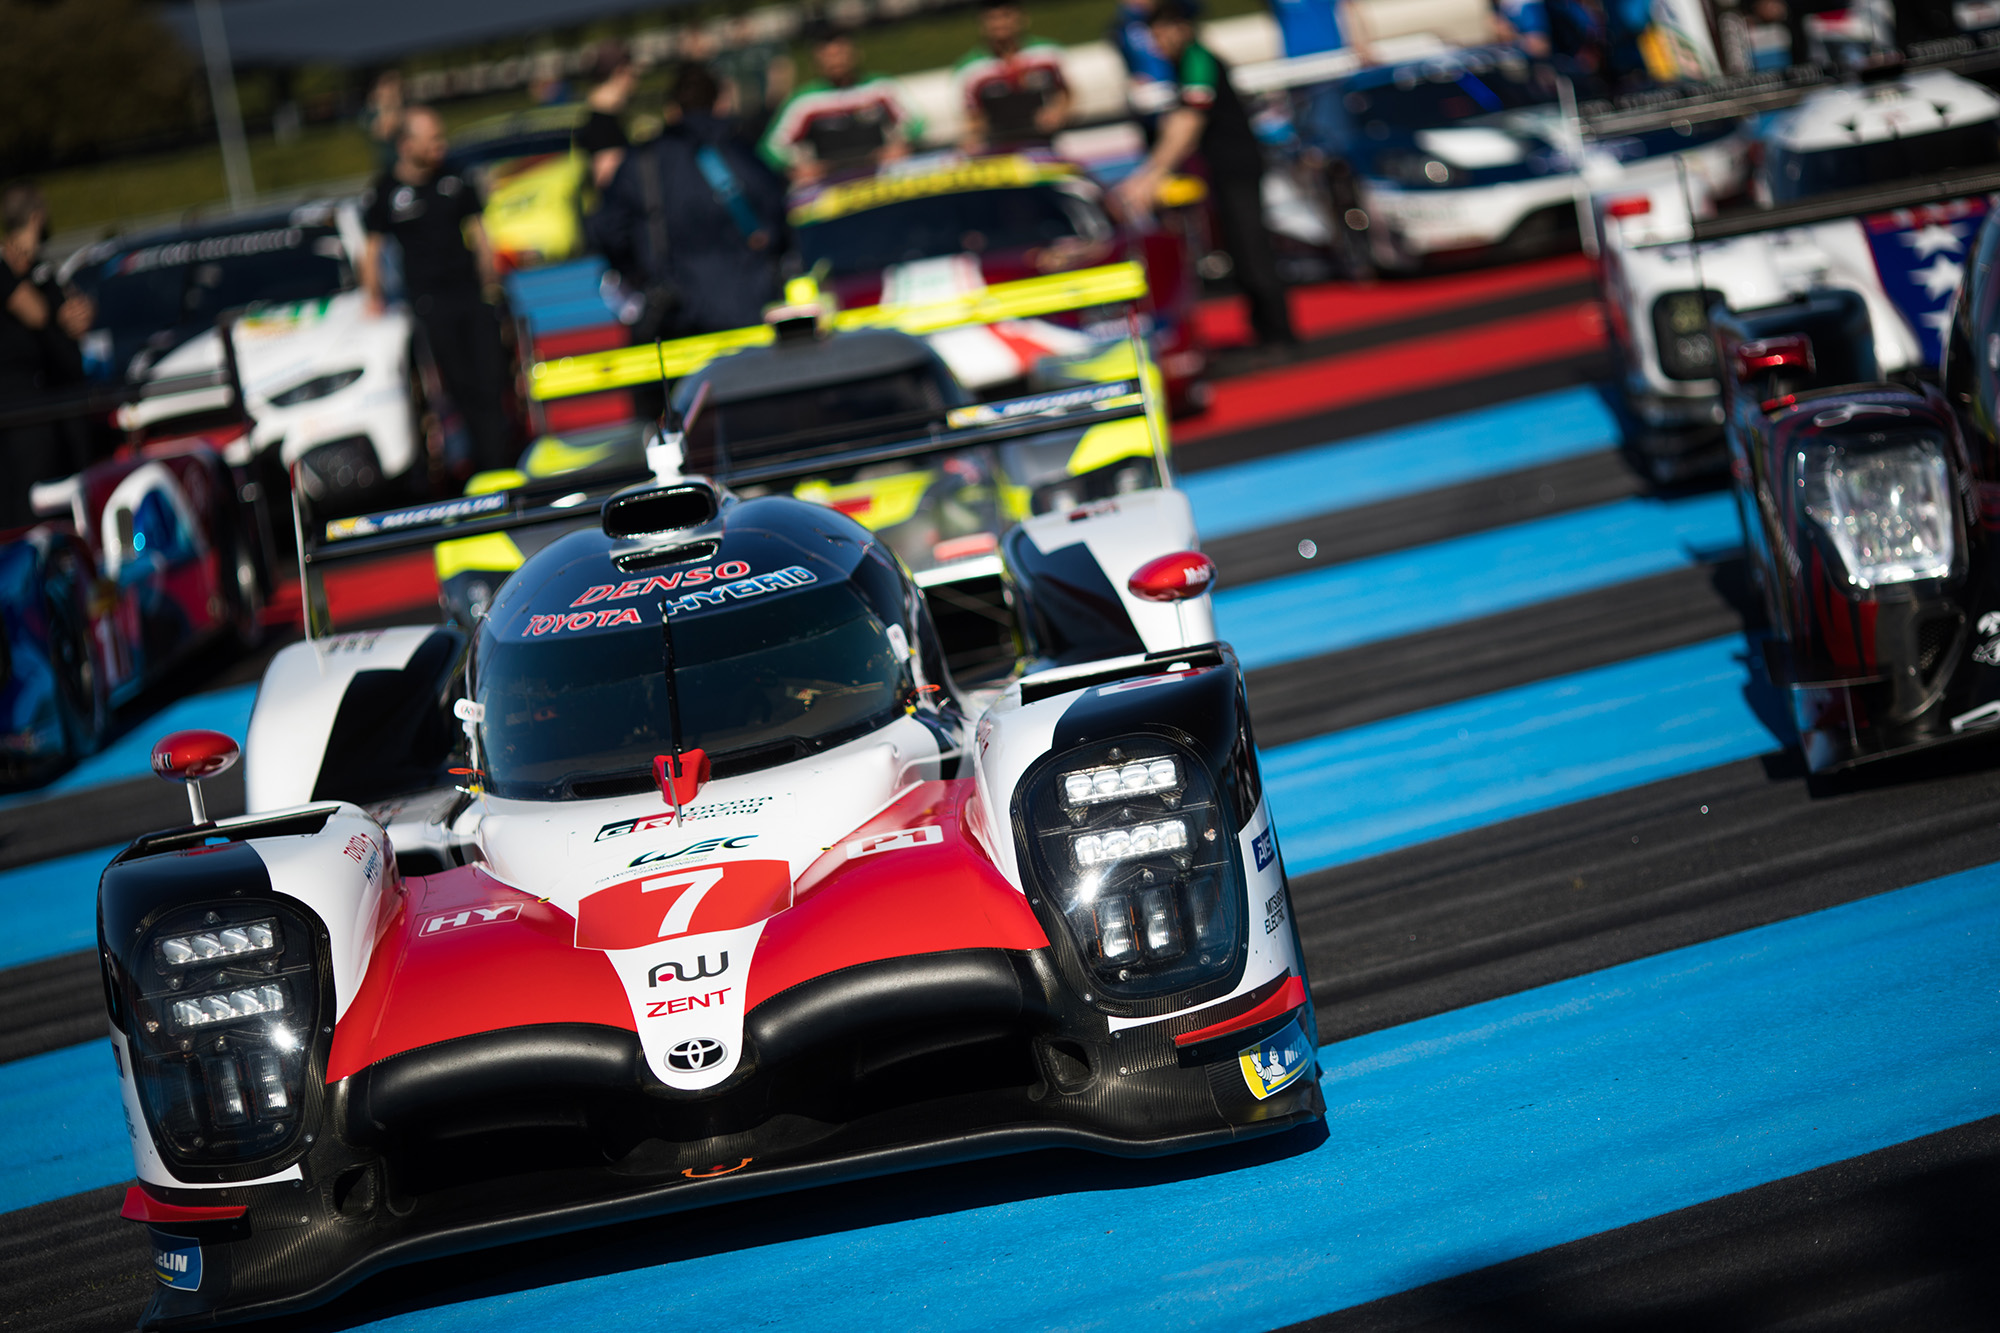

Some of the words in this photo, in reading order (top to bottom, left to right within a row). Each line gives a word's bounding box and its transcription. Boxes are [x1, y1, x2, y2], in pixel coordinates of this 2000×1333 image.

[570, 560, 750, 608] DENSO
[521, 607, 642, 637] TOYOTA
[657, 565, 818, 616] HYBRID
[684, 796, 773, 811] TOYOTA
[594, 811, 679, 842] GR
[861, 829, 927, 852] P1
[627, 834, 759, 868] WEC
[641, 867, 724, 938] 7
[427, 905, 516, 932] HY
[646, 987, 731, 1018] ZENT
